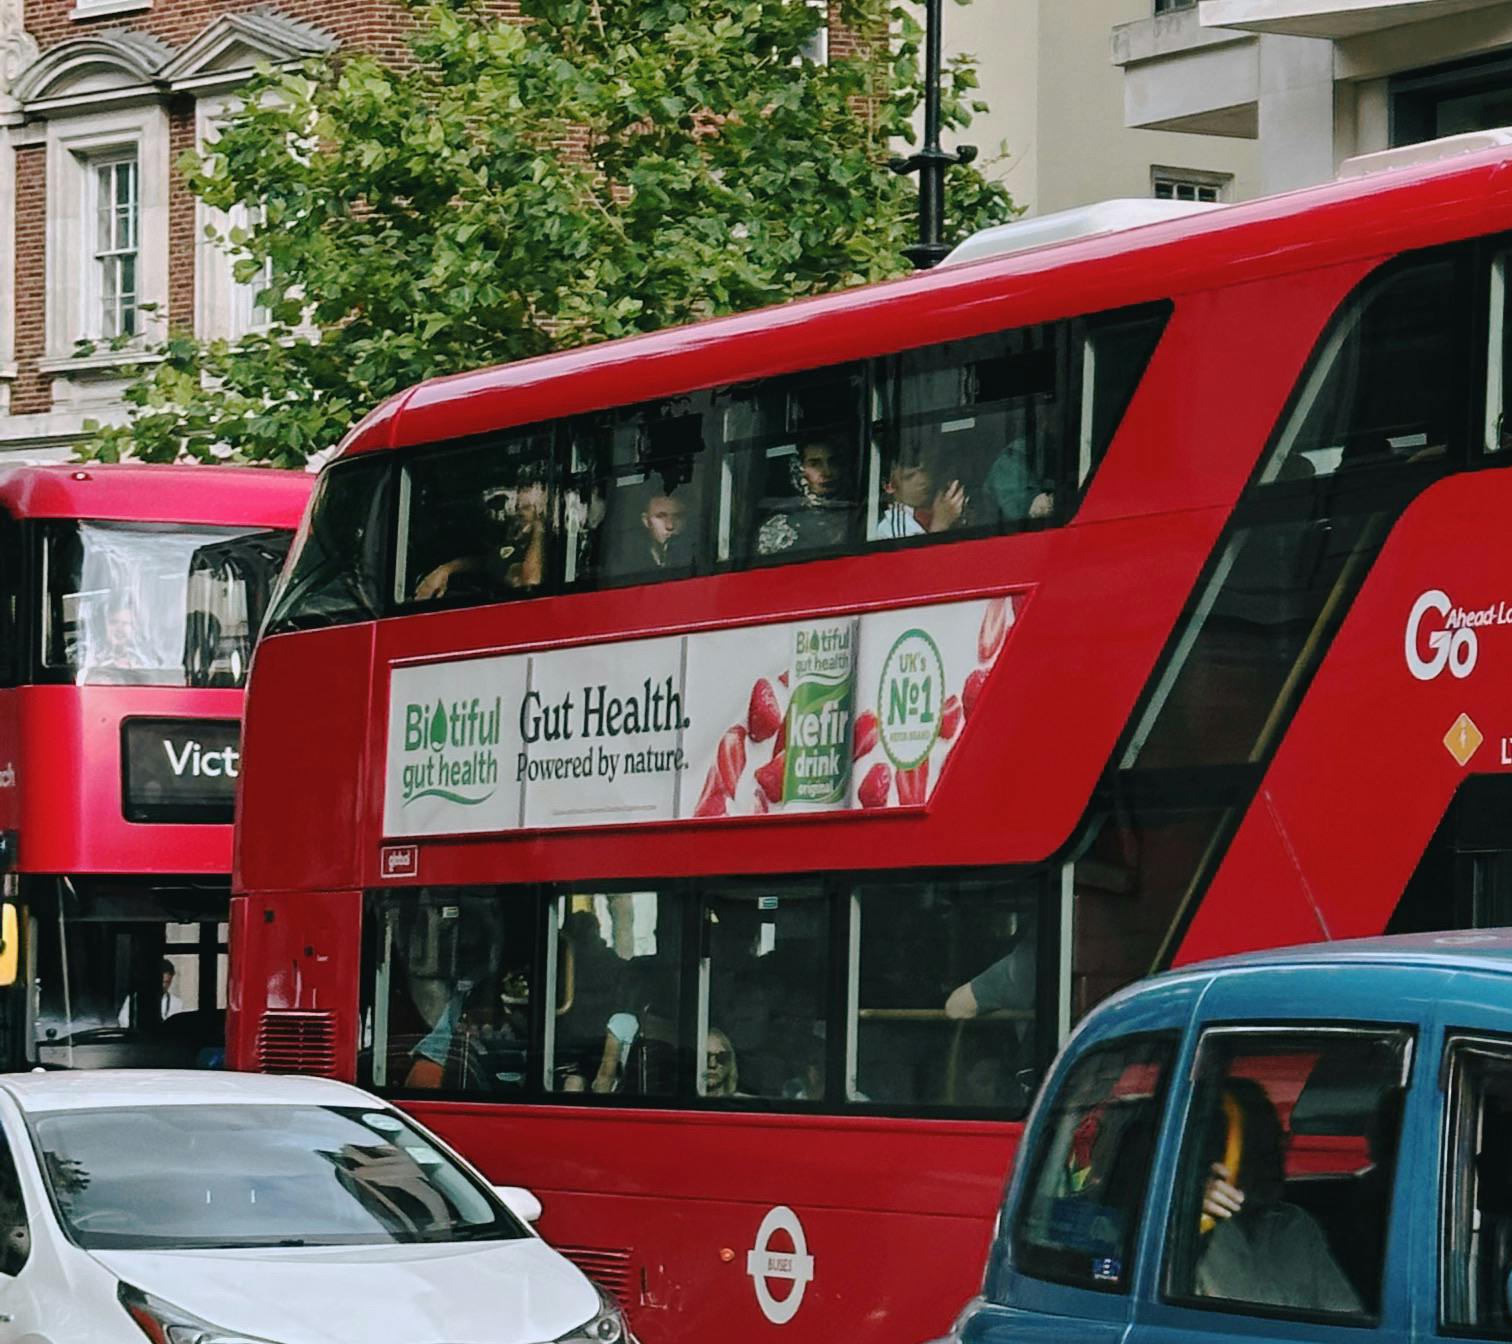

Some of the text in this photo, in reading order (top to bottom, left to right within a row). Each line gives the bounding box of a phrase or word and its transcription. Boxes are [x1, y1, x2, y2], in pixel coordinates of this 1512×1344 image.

[1404, 589, 1478, 681] Go
[519, 674, 690, 744] Gut Health.
[791, 699, 849, 748] kefir
[163, 739, 240, 778] Vict
[402, 750, 498, 799] gut health
[516, 744, 689, 783] Powered by nature.
[795, 748, 841, 778] drink
